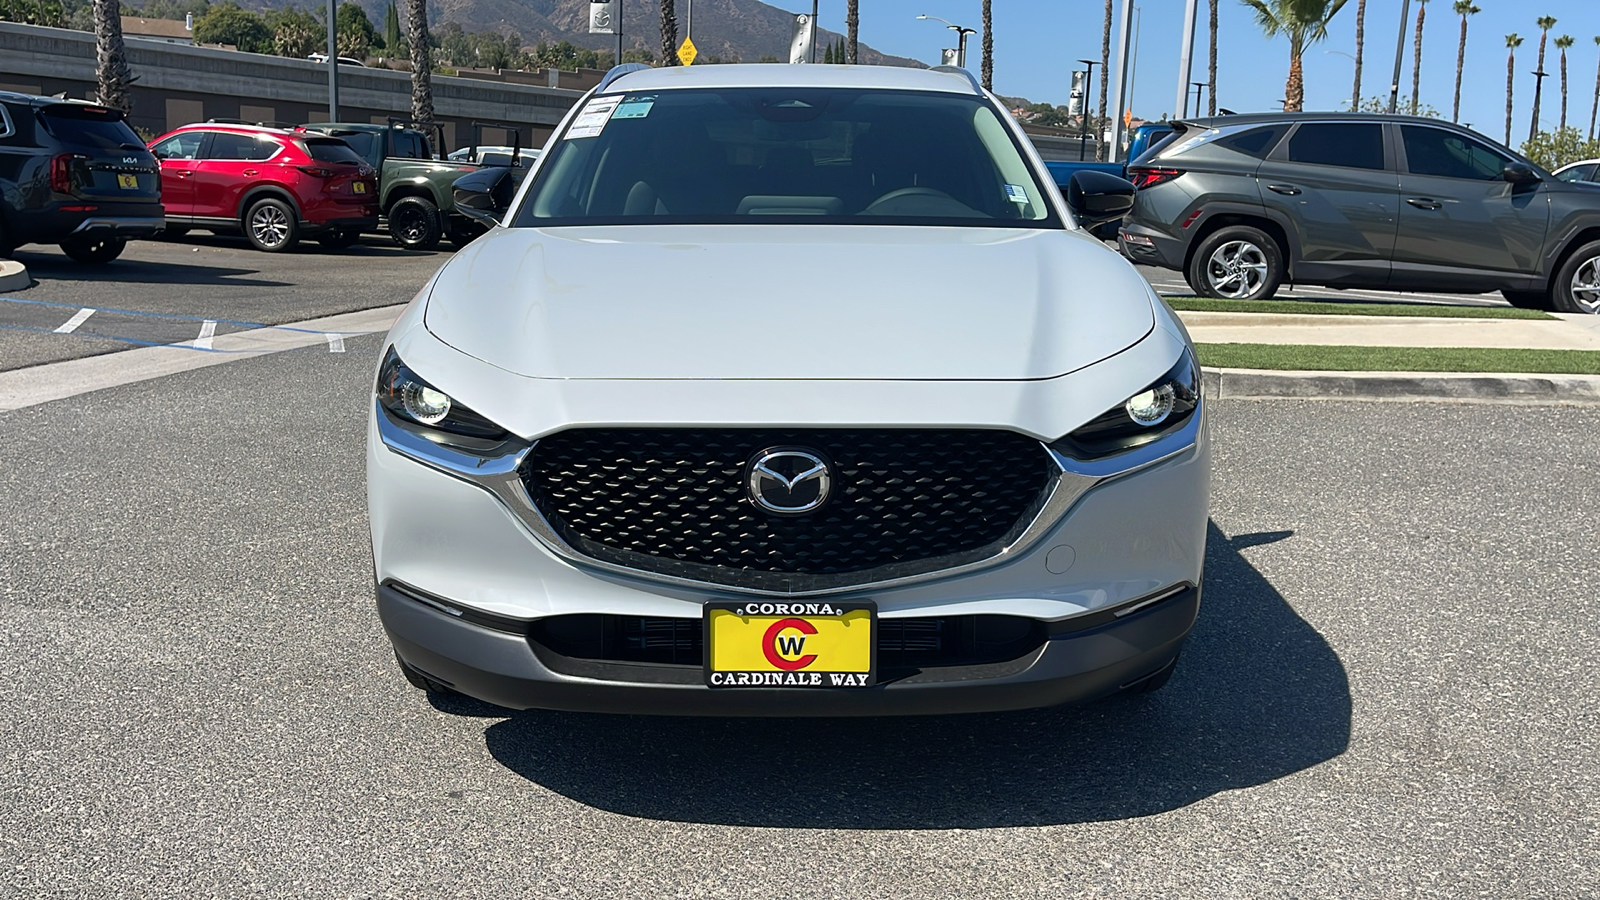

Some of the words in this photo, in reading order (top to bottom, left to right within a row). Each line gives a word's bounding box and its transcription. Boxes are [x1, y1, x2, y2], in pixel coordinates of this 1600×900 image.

[745, 603, 834, 615] CORONA
[711, 672, 822, 685] CARDINALE
[829, 674, 869, 686] WAY
